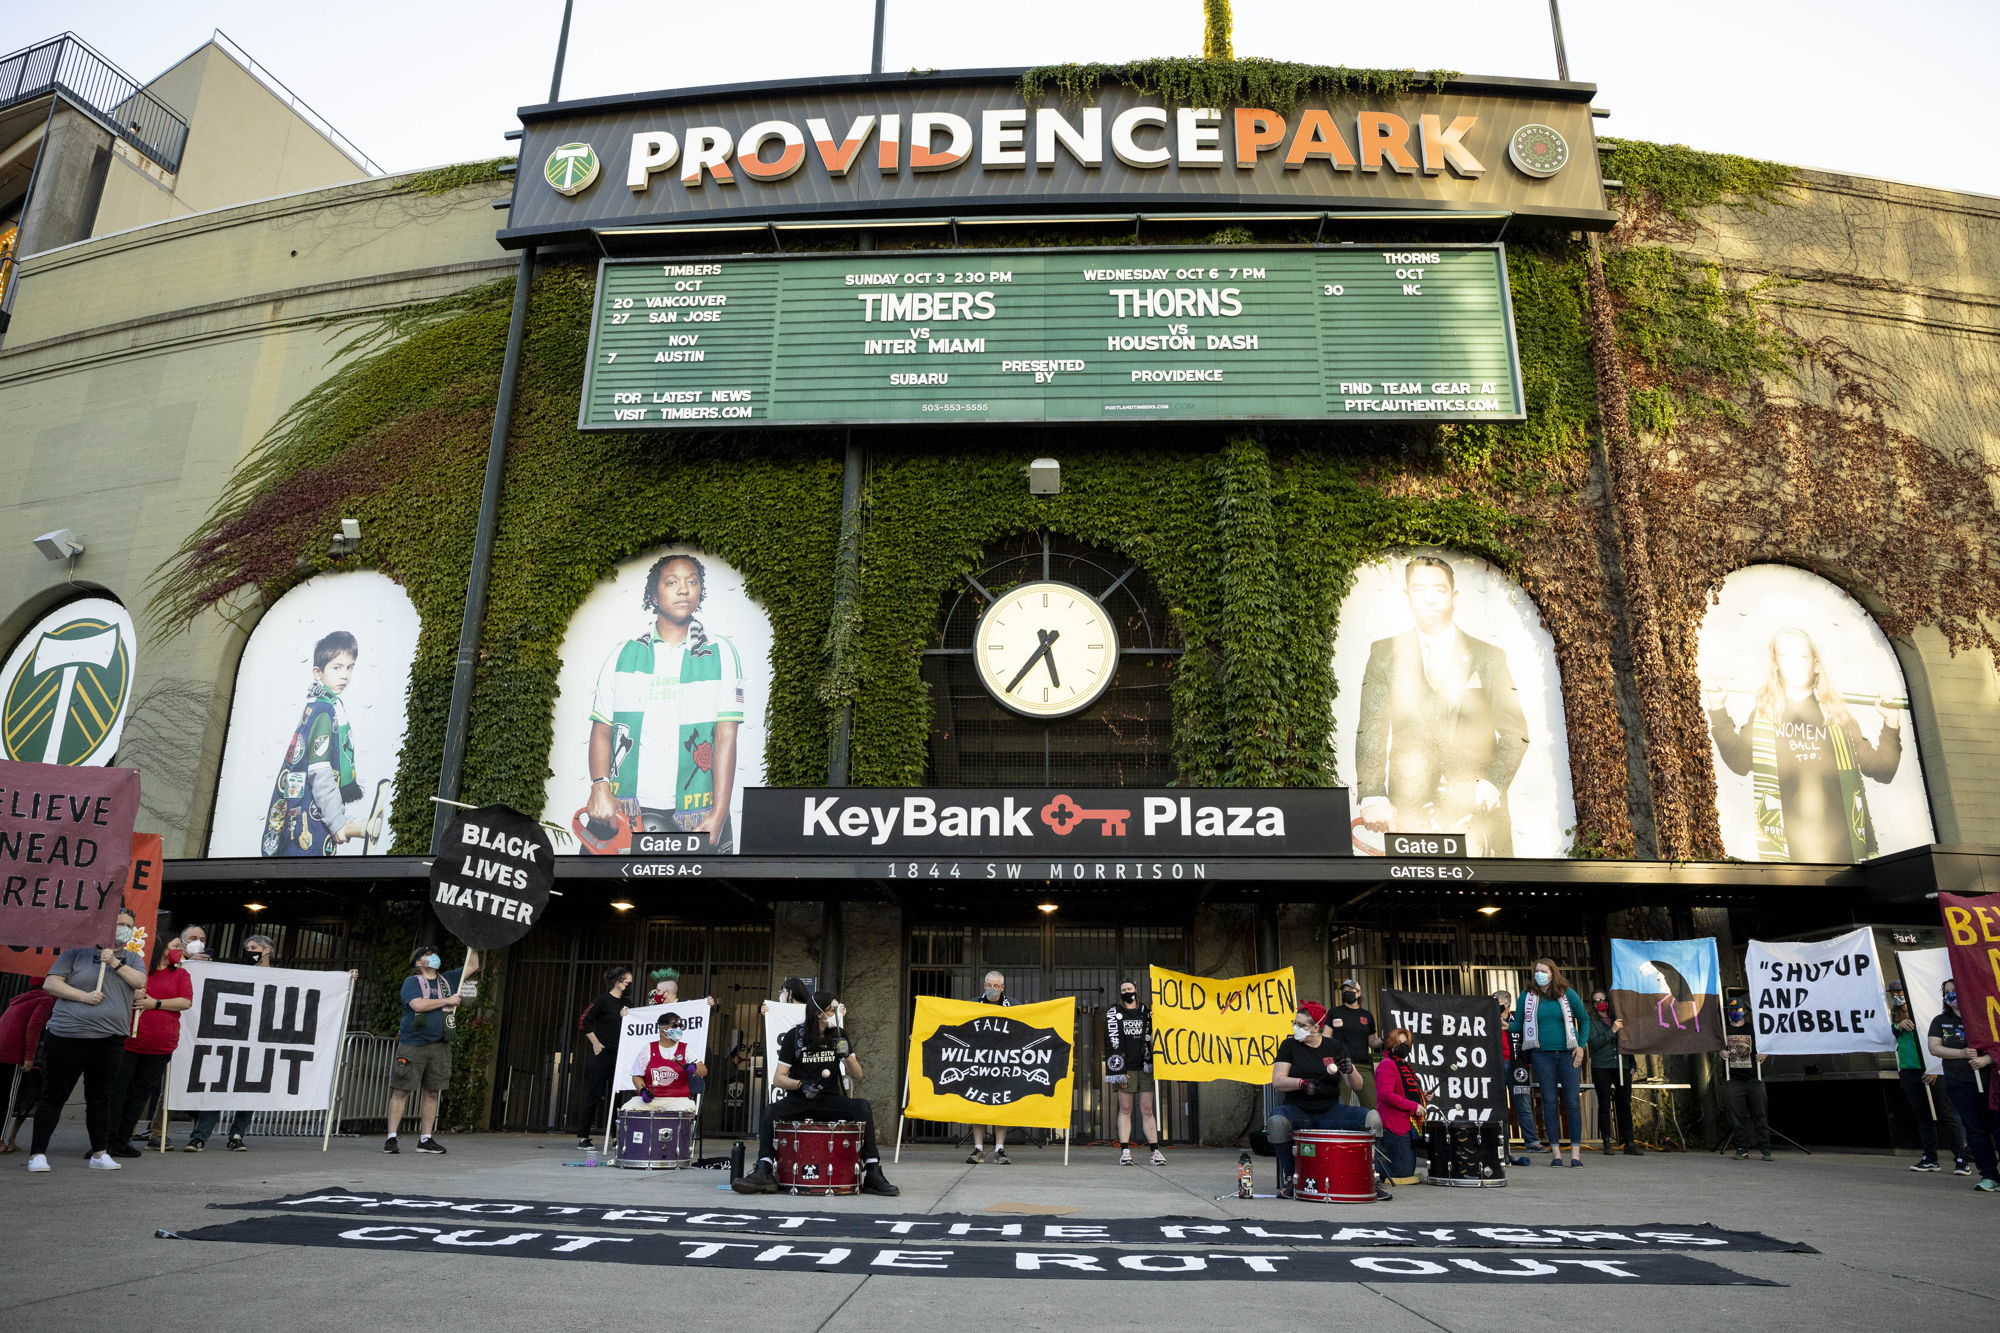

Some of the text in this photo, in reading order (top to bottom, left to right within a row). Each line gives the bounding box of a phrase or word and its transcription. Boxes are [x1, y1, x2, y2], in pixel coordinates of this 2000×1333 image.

[1518, 129, 1561, 146] PORTLAND
[626, 106, 1486, 191] PROVIDENCE PARK
[1521, 152, 1563, 169] THORNS
[1383, 252, 1441, 264] THORNS
[663, 265, 722, 276] TIMBERS
[845, 273, 899, 286] SUNDAY
[903, 272, 932, 285] OCT
[936, 272, 946, 284] 3
[989, 271, 1012, 283] PM
[1083, 267, 1266, 281] WEDNESDAY OCT 6 7 PM
[1395, 268, 1424, 280] OCT
[674, 280, 703, 292] OCT
[1324, 284, 1422, 296] 30 NC
[613, 295, 727, 309] 20 VANCOUVER
[857, 291, 996, 322] TIMBERS
[1109, 288, 1243, 318] THORNS
[611, 311, 721, 325] 27 SAN JOSE
[910, 328, 930, 339] VS
[1168, 324, 1188, 335] VS
[669, 335, 699, 346] NOV
[864, 338, 985, 355] INTER MIAMI
[1107, 335, 1258, 351] HOUSTON DASH
[607, 350, 704, 364] 7 AUSTIN
[1002, 359, 1085, 372] PRESENTED
[890, 373, 948, 385] SUBARU
[1034, 372, 1055, 384] BY
[1131, 370, 1223, 382] PROVIDENCE
[1340, 382, 1497, 395] FIND TEAM GEAR AT
[614, 390, 751, 405] FOR LATEST NEWS
[1345, 399, 1499, 412] PTFCAUTHENTICS.COM
[614, 406, 752, 421] VISIT TIMBERS.COM
[922, 403, 988, 412] 503-553-5555
[1775, 722, 1826, 741] WOMEN
[1789, 739, 1820, 751] BALL
[803, 796, 1285, 845] KeyBank Plaza
[461, 823, 541, 862] BLACK
[640, 836, 700, 852] Gate D
[1394, 838, 1458, 855] Gate D
[460, 855, 528, 890] LIVES
[632, 863, 702, 876] GATES A-C
[888, 863, 1207, 879] 1844 SW MORRISON
[1390, 865, 1463, 879] GATES E-G
[2, 875, 114, 911] RELLY
[435, 881, 533, 925] MATTER
[1944, 906, 2000, 946] BE
[1151, 978, 1205, 1010] HOLD
[1759, 988, 1808, 1009] AND
[197, 978, 320, 1045] GW
[973, 1018, 1010, 1034] FALL
[1390, 1010, 1487, 1037] THE BAR
[1759, 1010, 1875, 1034] DRIBBLE"
[1152, 1028, 1295, 1067] ACCOUNTAB
[941, 1047, 1052, 1065] WILKINSON
[1455, 1046, 1487, 1068] SO
[187, 1045, 314, 1095] OUT
[969, 1065, 1021, 1078] SWORD
[965, 1086, 1011, 1104] HERE
[1447, 1076, 1492, 1099] BUT
[875, 1220, 1110, 1237] THE
[338, 1226, 1640, 1278] CUT THE ROT OUT
